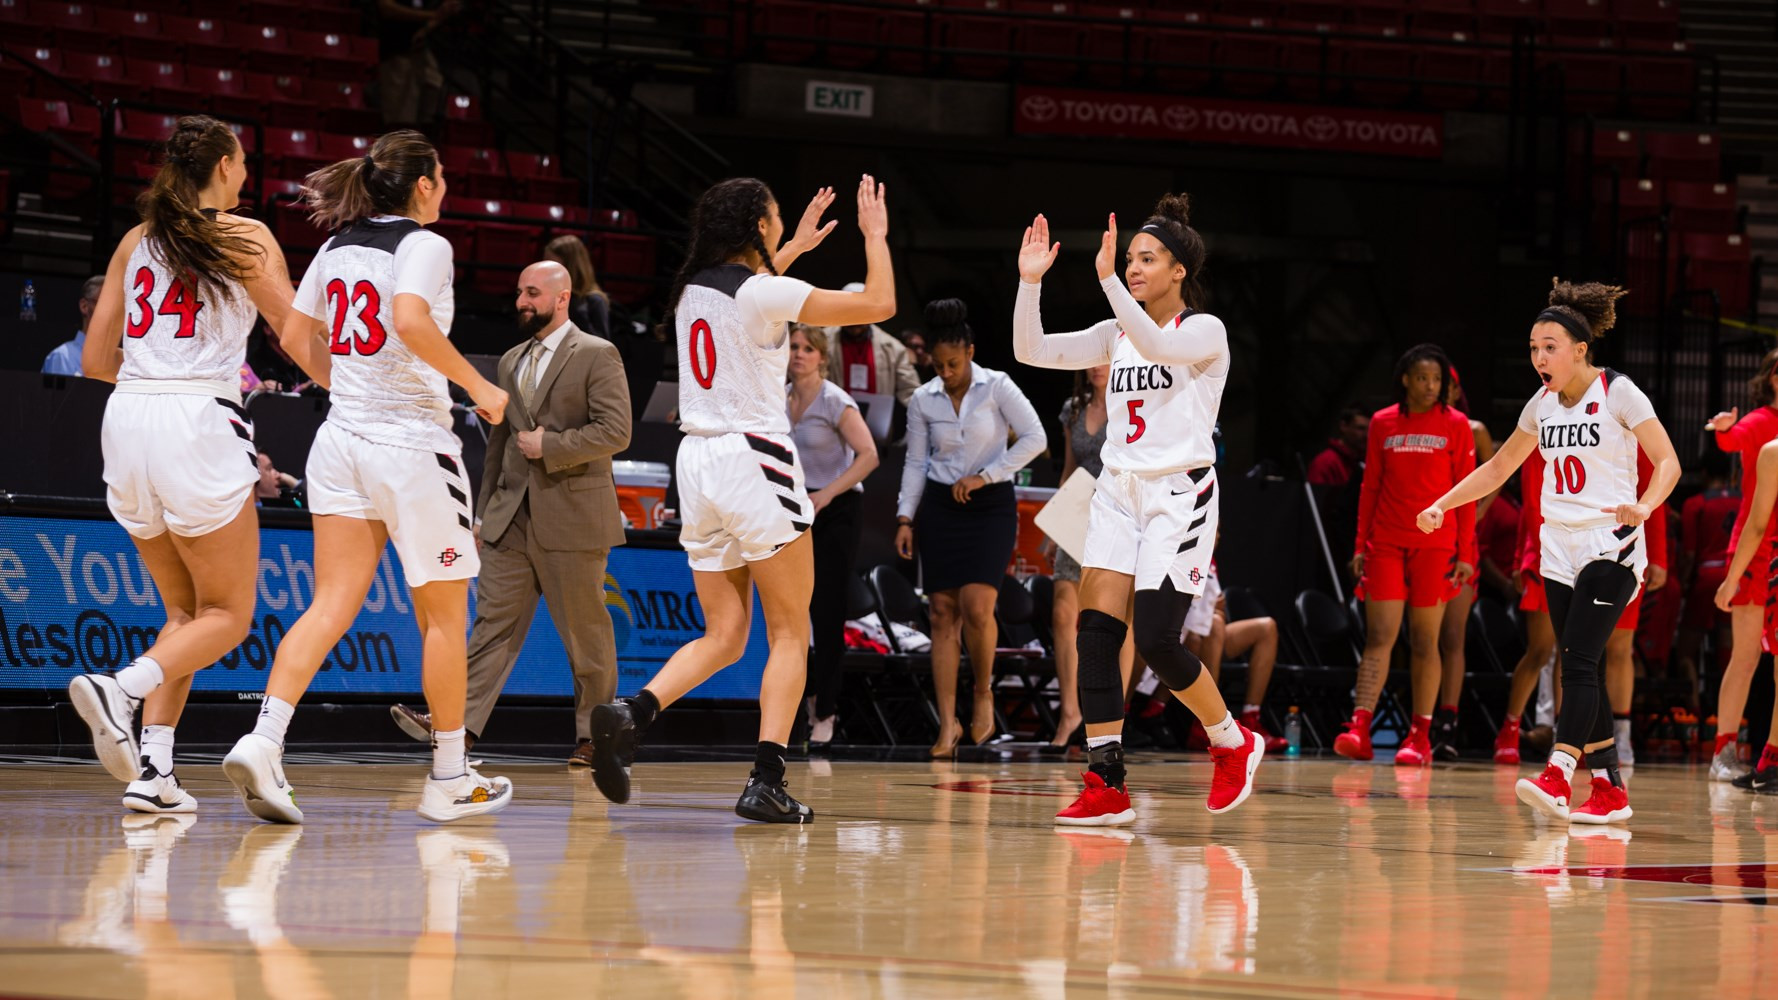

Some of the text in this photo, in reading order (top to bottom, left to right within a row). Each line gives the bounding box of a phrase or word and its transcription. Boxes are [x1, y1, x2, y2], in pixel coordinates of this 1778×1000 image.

[813, 86, 865, 112] EXIT
[1062, 100, 1438, 146] TOYOTA TOYOTA TOYOTA
[127, 266, 204, 339] 34
[326, 278, 387, 356] 23
[689, 318, 717, 390] 0
[1110, 364, 1173, 395] AZTECS
[1126, 399, 1147, 444] 5
[1540, 422, 1601, 450] AZTECS
[1553, 454, 1587, 495] 10
